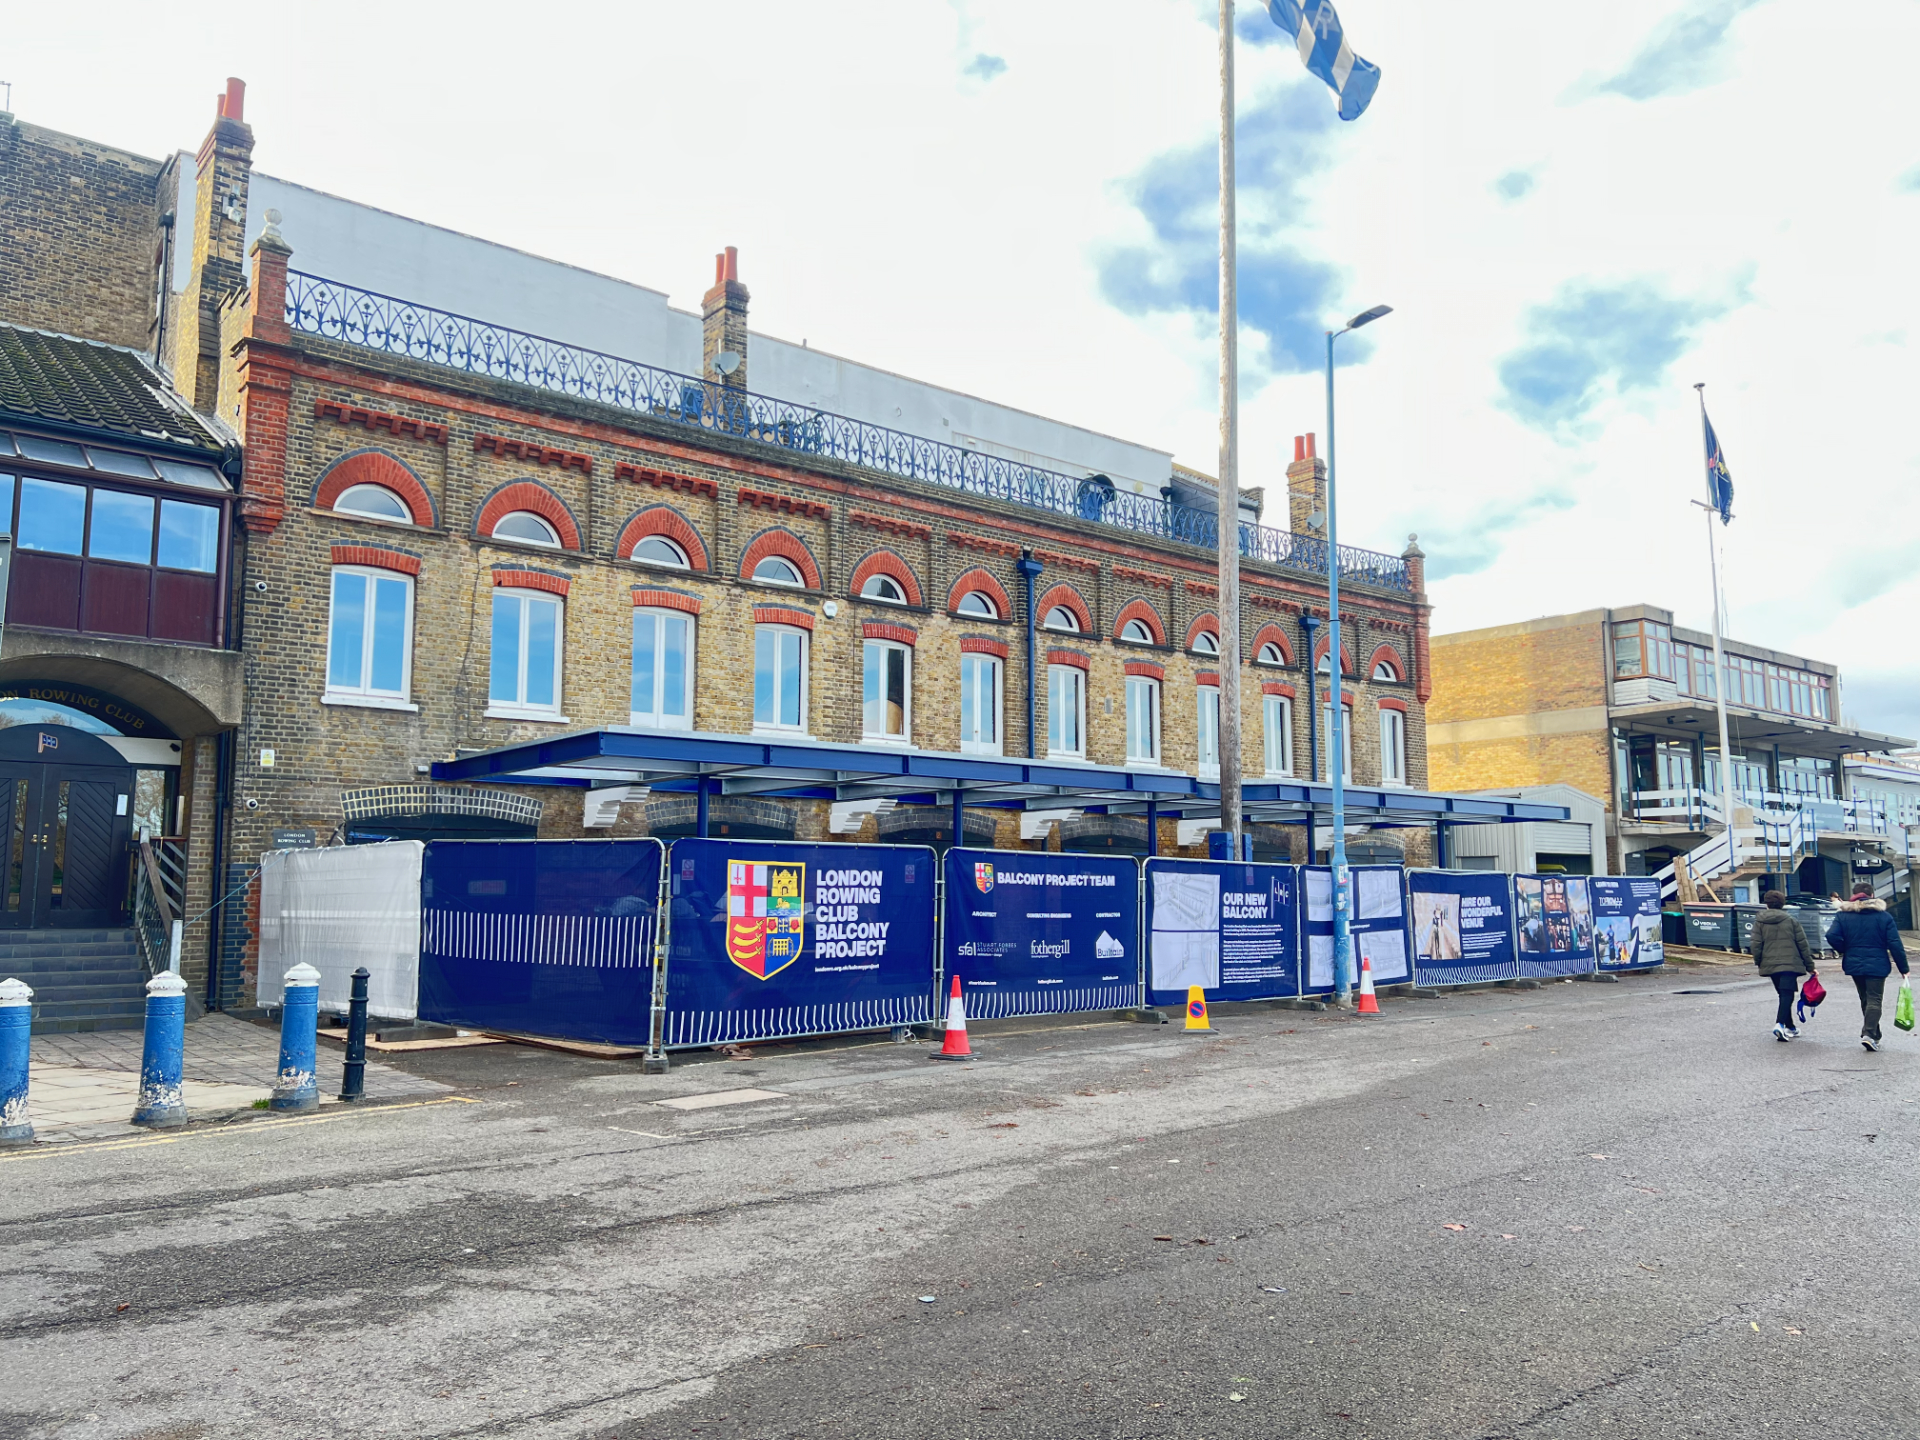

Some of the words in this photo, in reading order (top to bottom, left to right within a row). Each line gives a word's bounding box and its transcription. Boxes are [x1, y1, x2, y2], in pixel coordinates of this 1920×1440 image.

[28, 688, 100, 709] ROWING
[105, 703, 145, 729] CLUB
[816, 869, 883, 887] LONDON
[997, 872, 1045, 885] BALCONY
[1046, 874, 1089, 886] PROJECT
[1090, 875, 1116, 887] TEAM
[816, 887, 881, 905] ROWING
[1223, 892, 1244, 906] OUR
[1245, 893, 1267, 906] NEW
[1461, 896, 1477, 907] HIRE
[1477, 896, 1492, 907] OUR
[815, 905, 859, 923] CLUB
[1223, 906, 1268, 919] BALCONY
[1461, 905, 1504, 918] WONDERFUL
[815, 922, 890, 941] BALCONY
[1461, 917, 1484, 929] VENUE
[815, 939, 887, 959] PROJECT
[1030, 939, 1070, 959] fothergill
